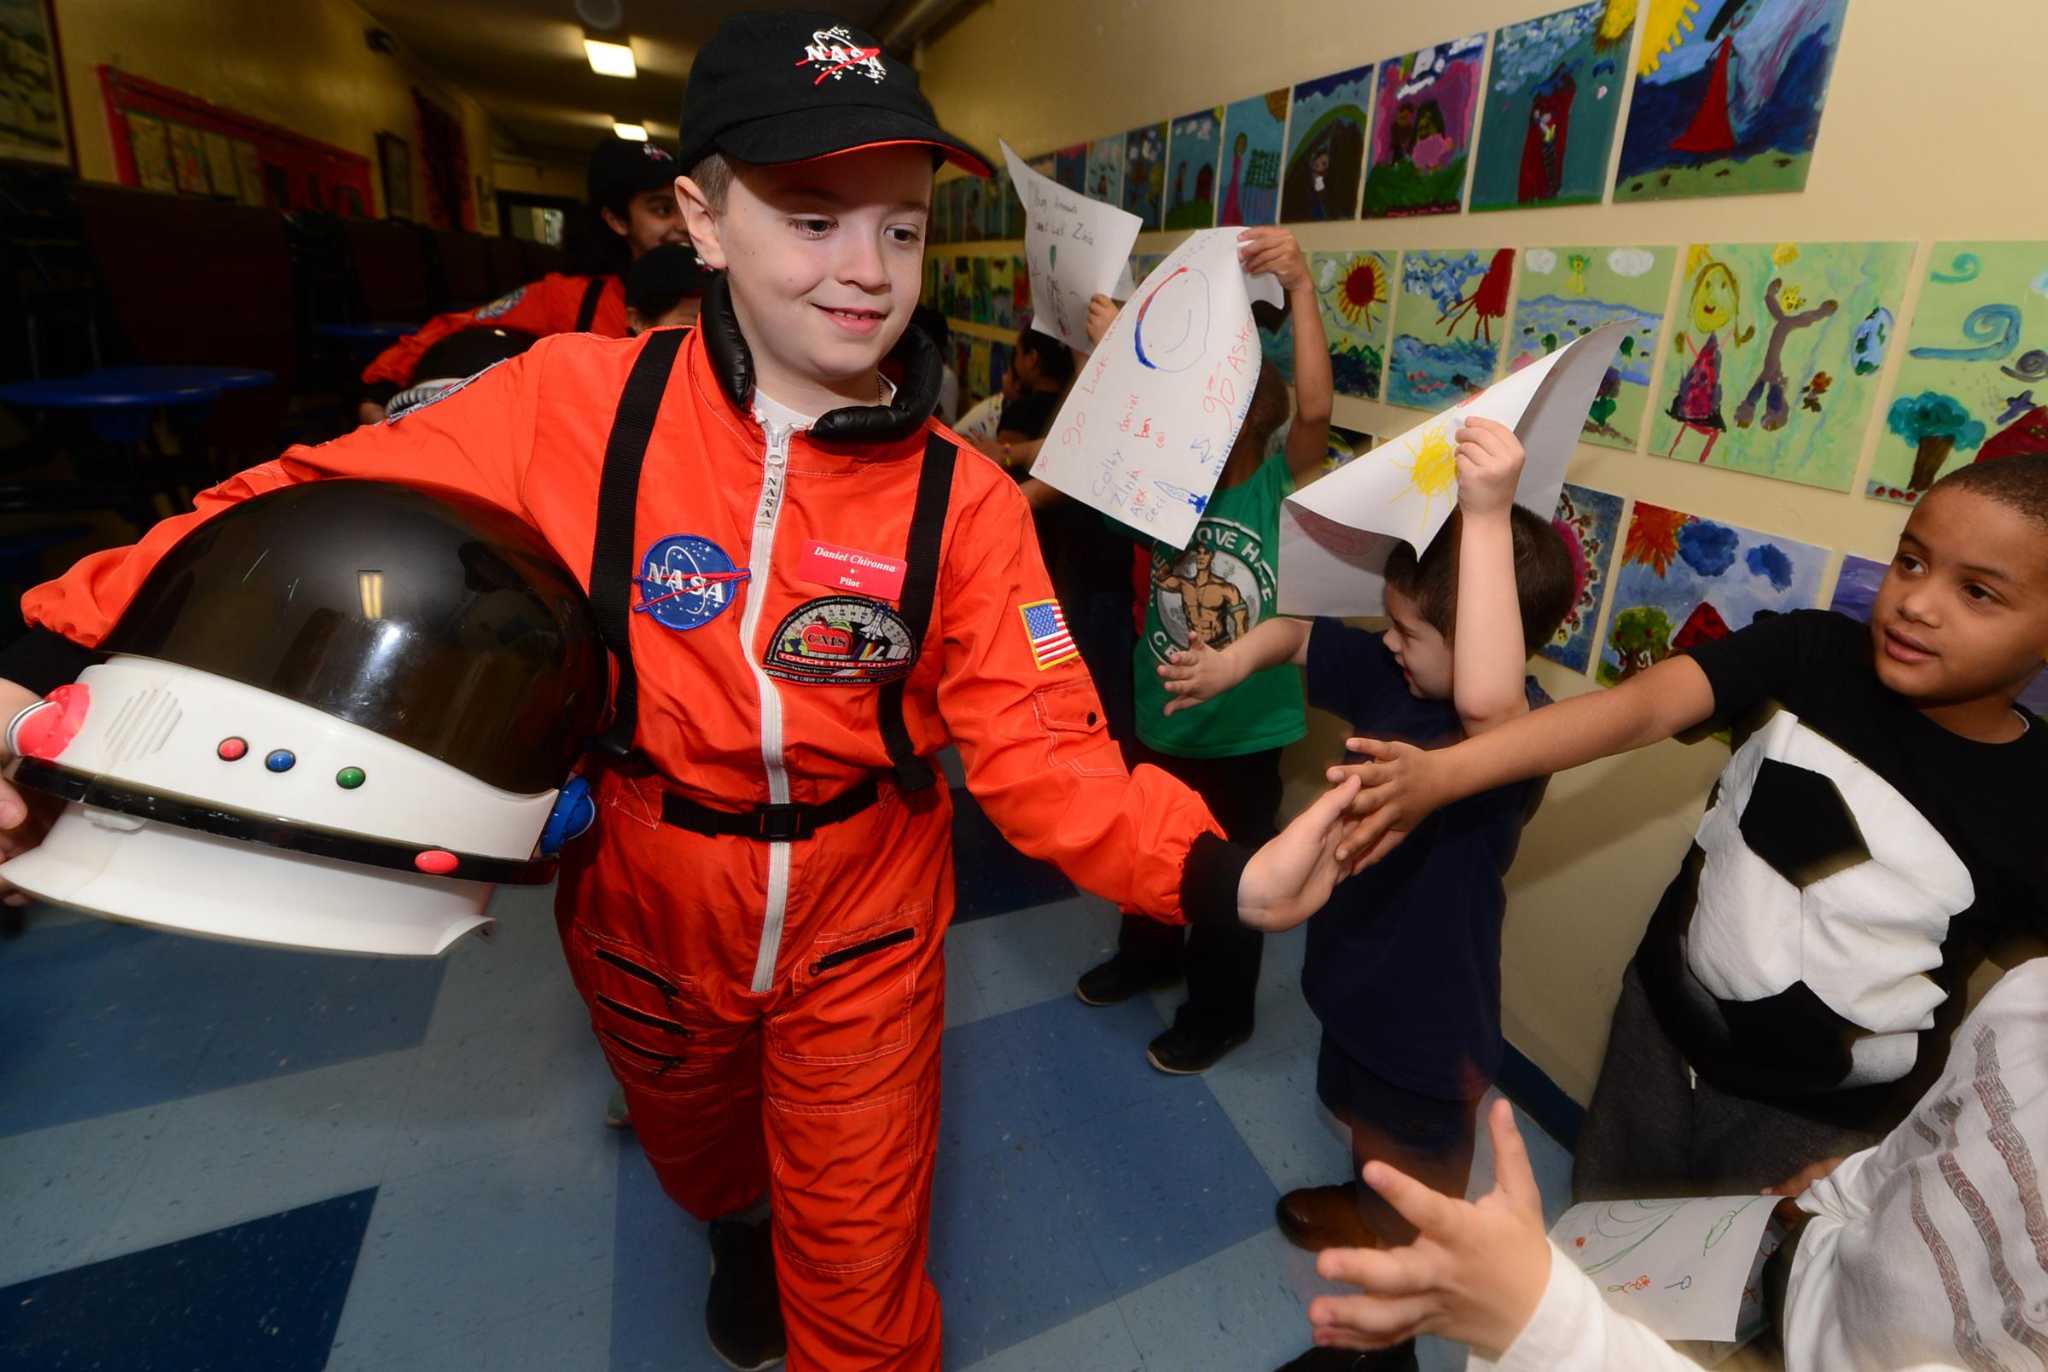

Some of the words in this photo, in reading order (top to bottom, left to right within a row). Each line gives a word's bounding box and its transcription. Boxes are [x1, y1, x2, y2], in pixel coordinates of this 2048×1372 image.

[803, 44, 887, 81] NASA
[760, 476, 777, 518] NASA
[1195, 526, 1239, 550] OVE
[814, 546, 849, 562] Daniel
[849, 554, 897, 573] Chironna
[647, 562, 725, 604] NASA
[840, 576, 860, 588] Pilot
[778, 652, 824, 666] TOUCH
[830, 660, 856, 668] THE
